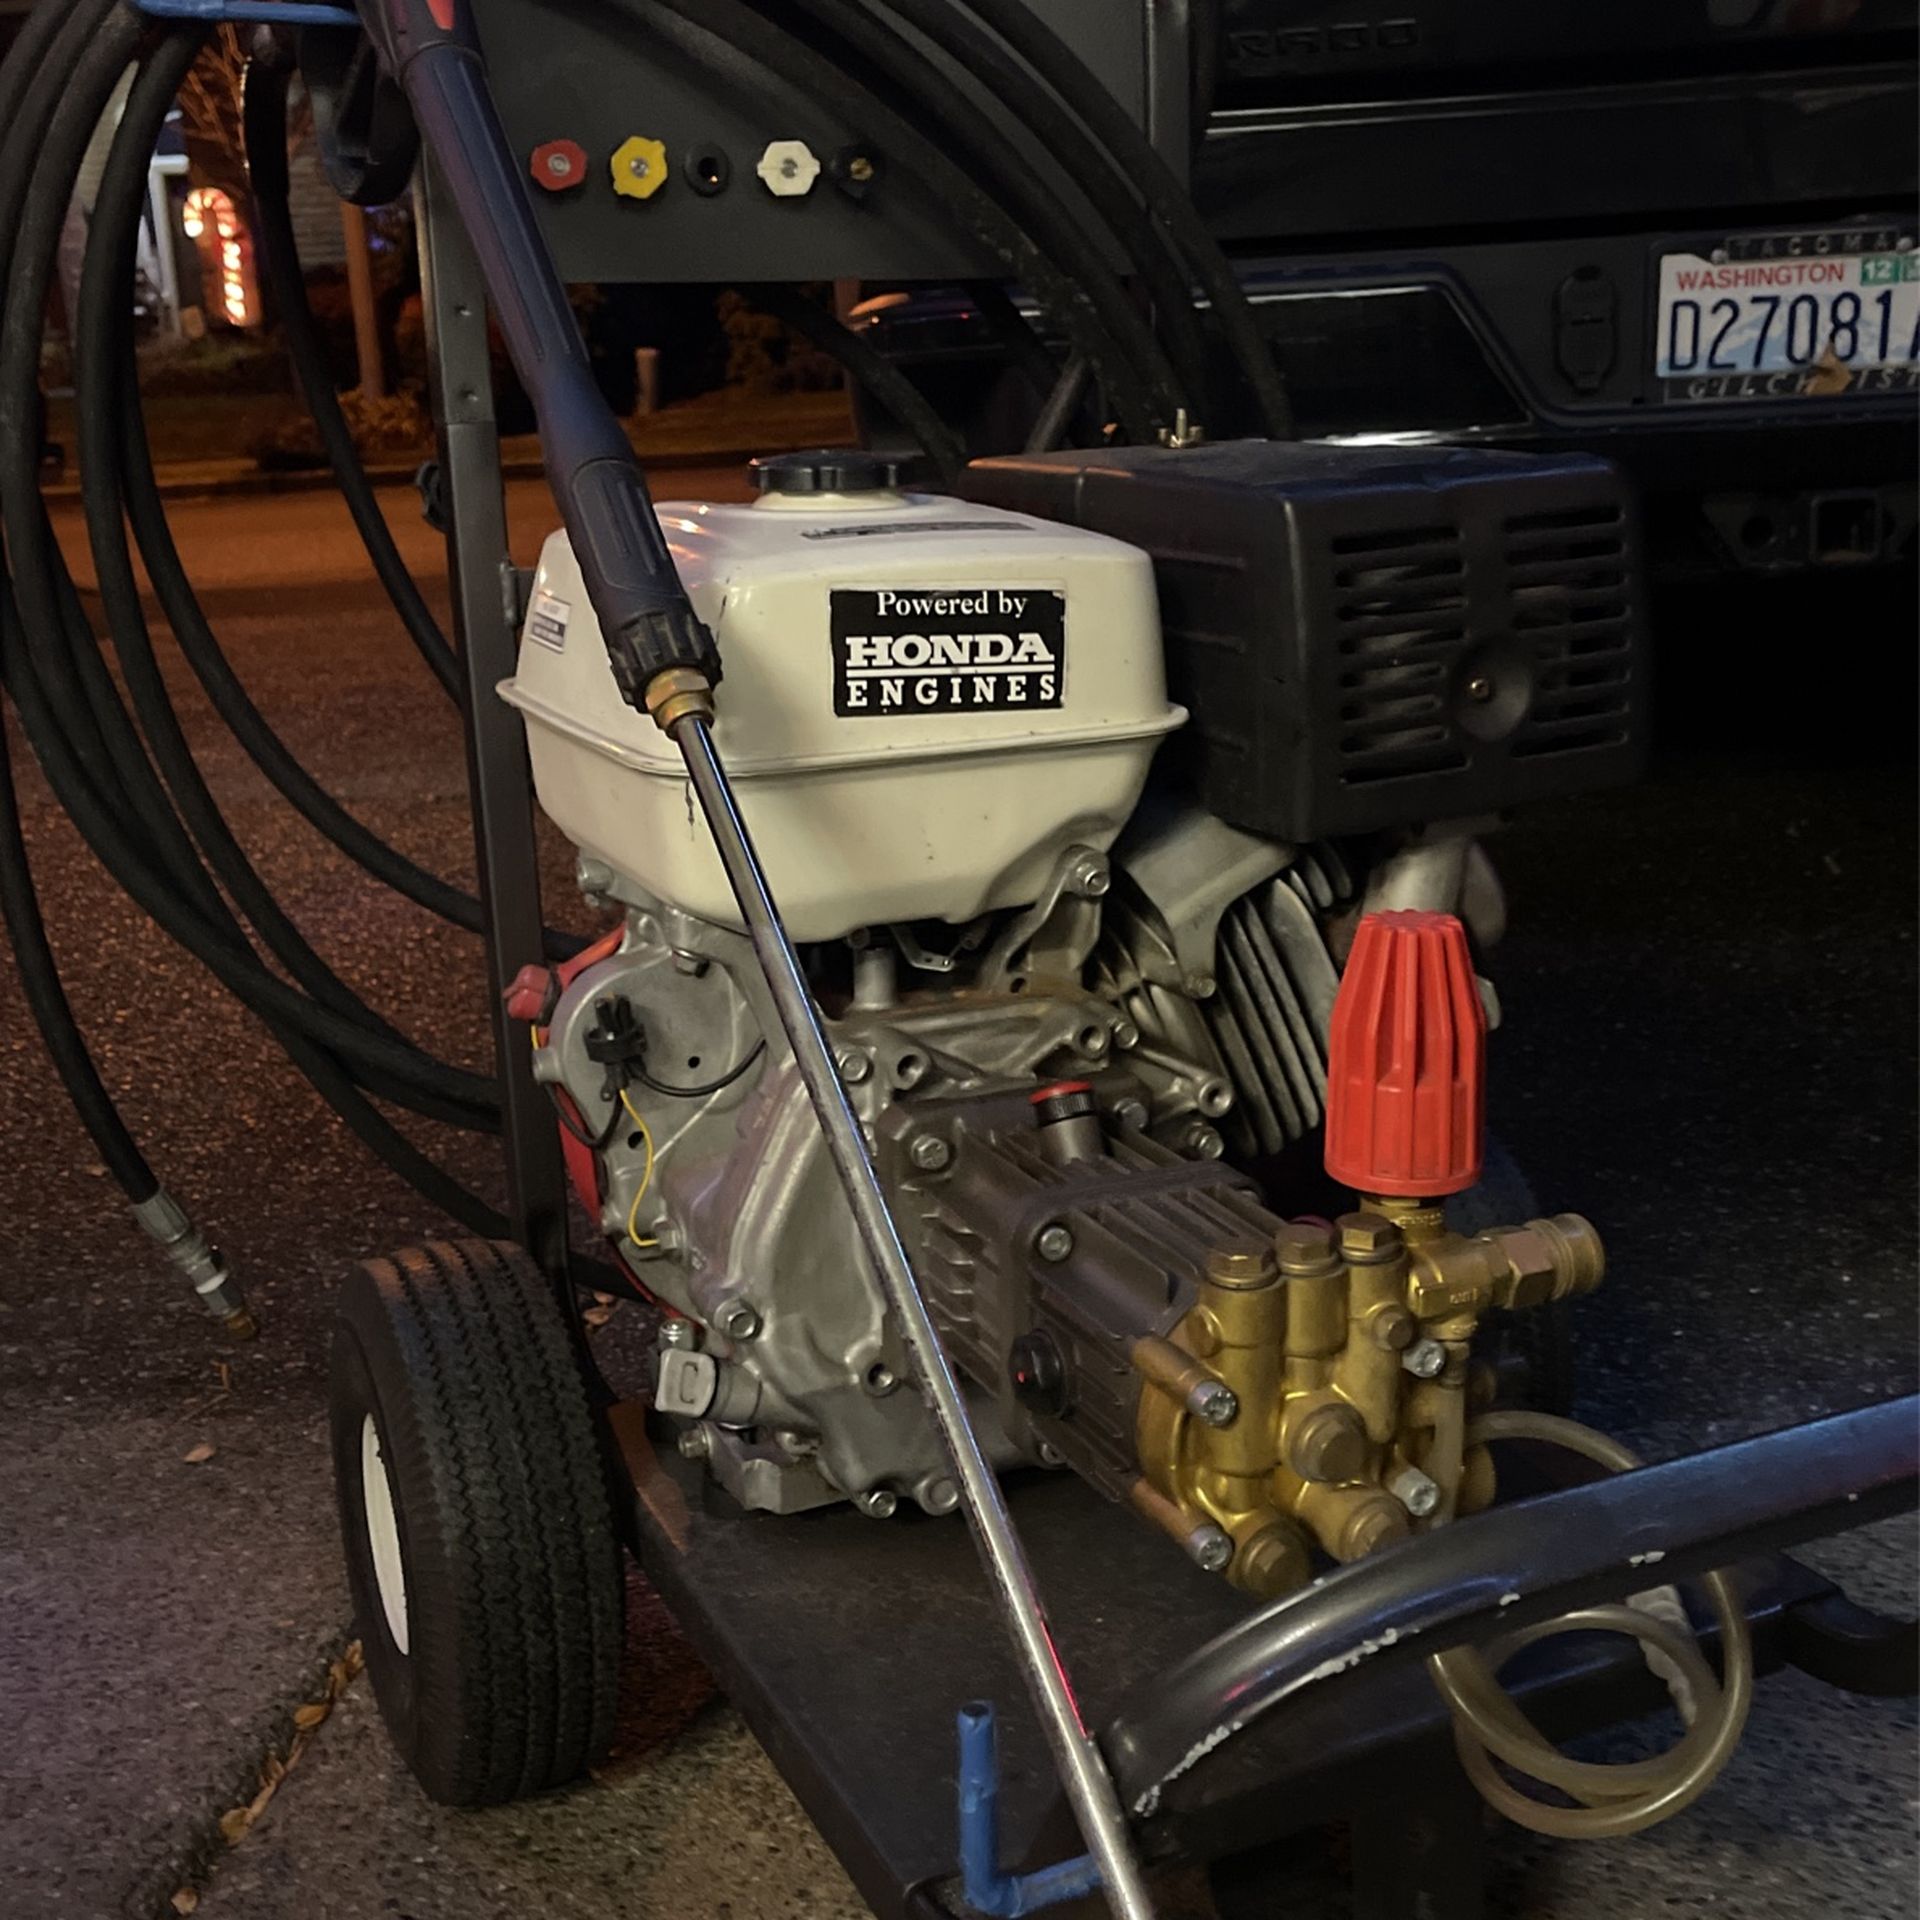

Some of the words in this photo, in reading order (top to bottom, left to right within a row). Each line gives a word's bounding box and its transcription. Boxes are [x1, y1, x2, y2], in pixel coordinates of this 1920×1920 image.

[1735, 233, 1891, 257] TACOMA
[1676, 262, 1845, 290] WASHINGTON
[1863, 261, 1892, 281] 12
[877, 590, 988, 616] Powered
[999, 590, 1028, 618] by
[846, 633, 1055, 667] HONDA
[847, 674, 1055, 707] ENGINES
